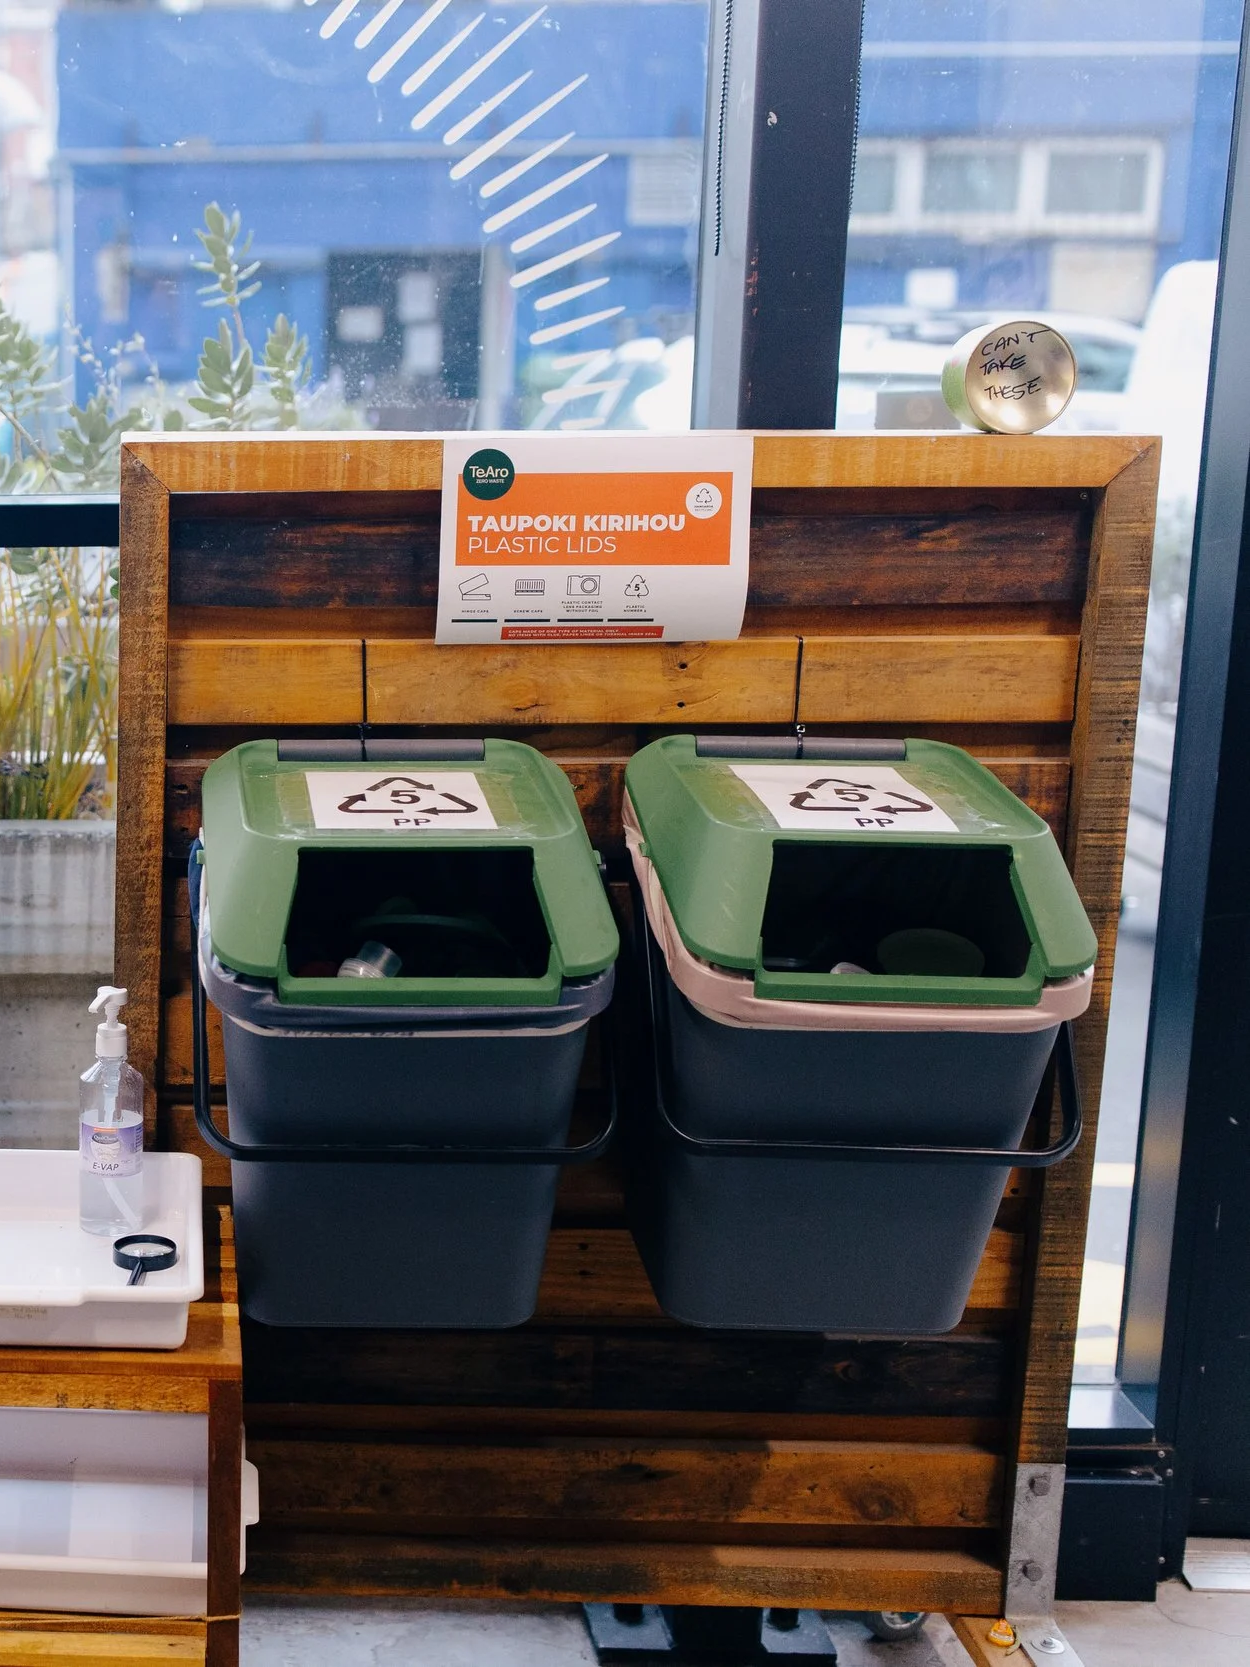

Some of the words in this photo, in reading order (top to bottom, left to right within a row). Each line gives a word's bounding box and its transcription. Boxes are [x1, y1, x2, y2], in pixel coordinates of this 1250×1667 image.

[981, 328, 1051, 356] CAN'T
[979, 353, 1027, 375] TAKE
[984, 376, 1042, 400] THESE
[469, 466, 509, 478] TeAro
[467, 515, 576, 532] TAUPOKI
[583, 514, 686, 531] KIRIHOU
[468, 537, 560, 553] PLASTIC
[566, 536, 617, 553] LIDS
[634, 583, 641, 591] 5
[390, 790, 421, 805] 5
[833, 788, 870, 802] 5
[393, 818, 431, 826] PP
[854, 818, 895, 828] PP
[92, 1162, 119, 1171] E-VAP
